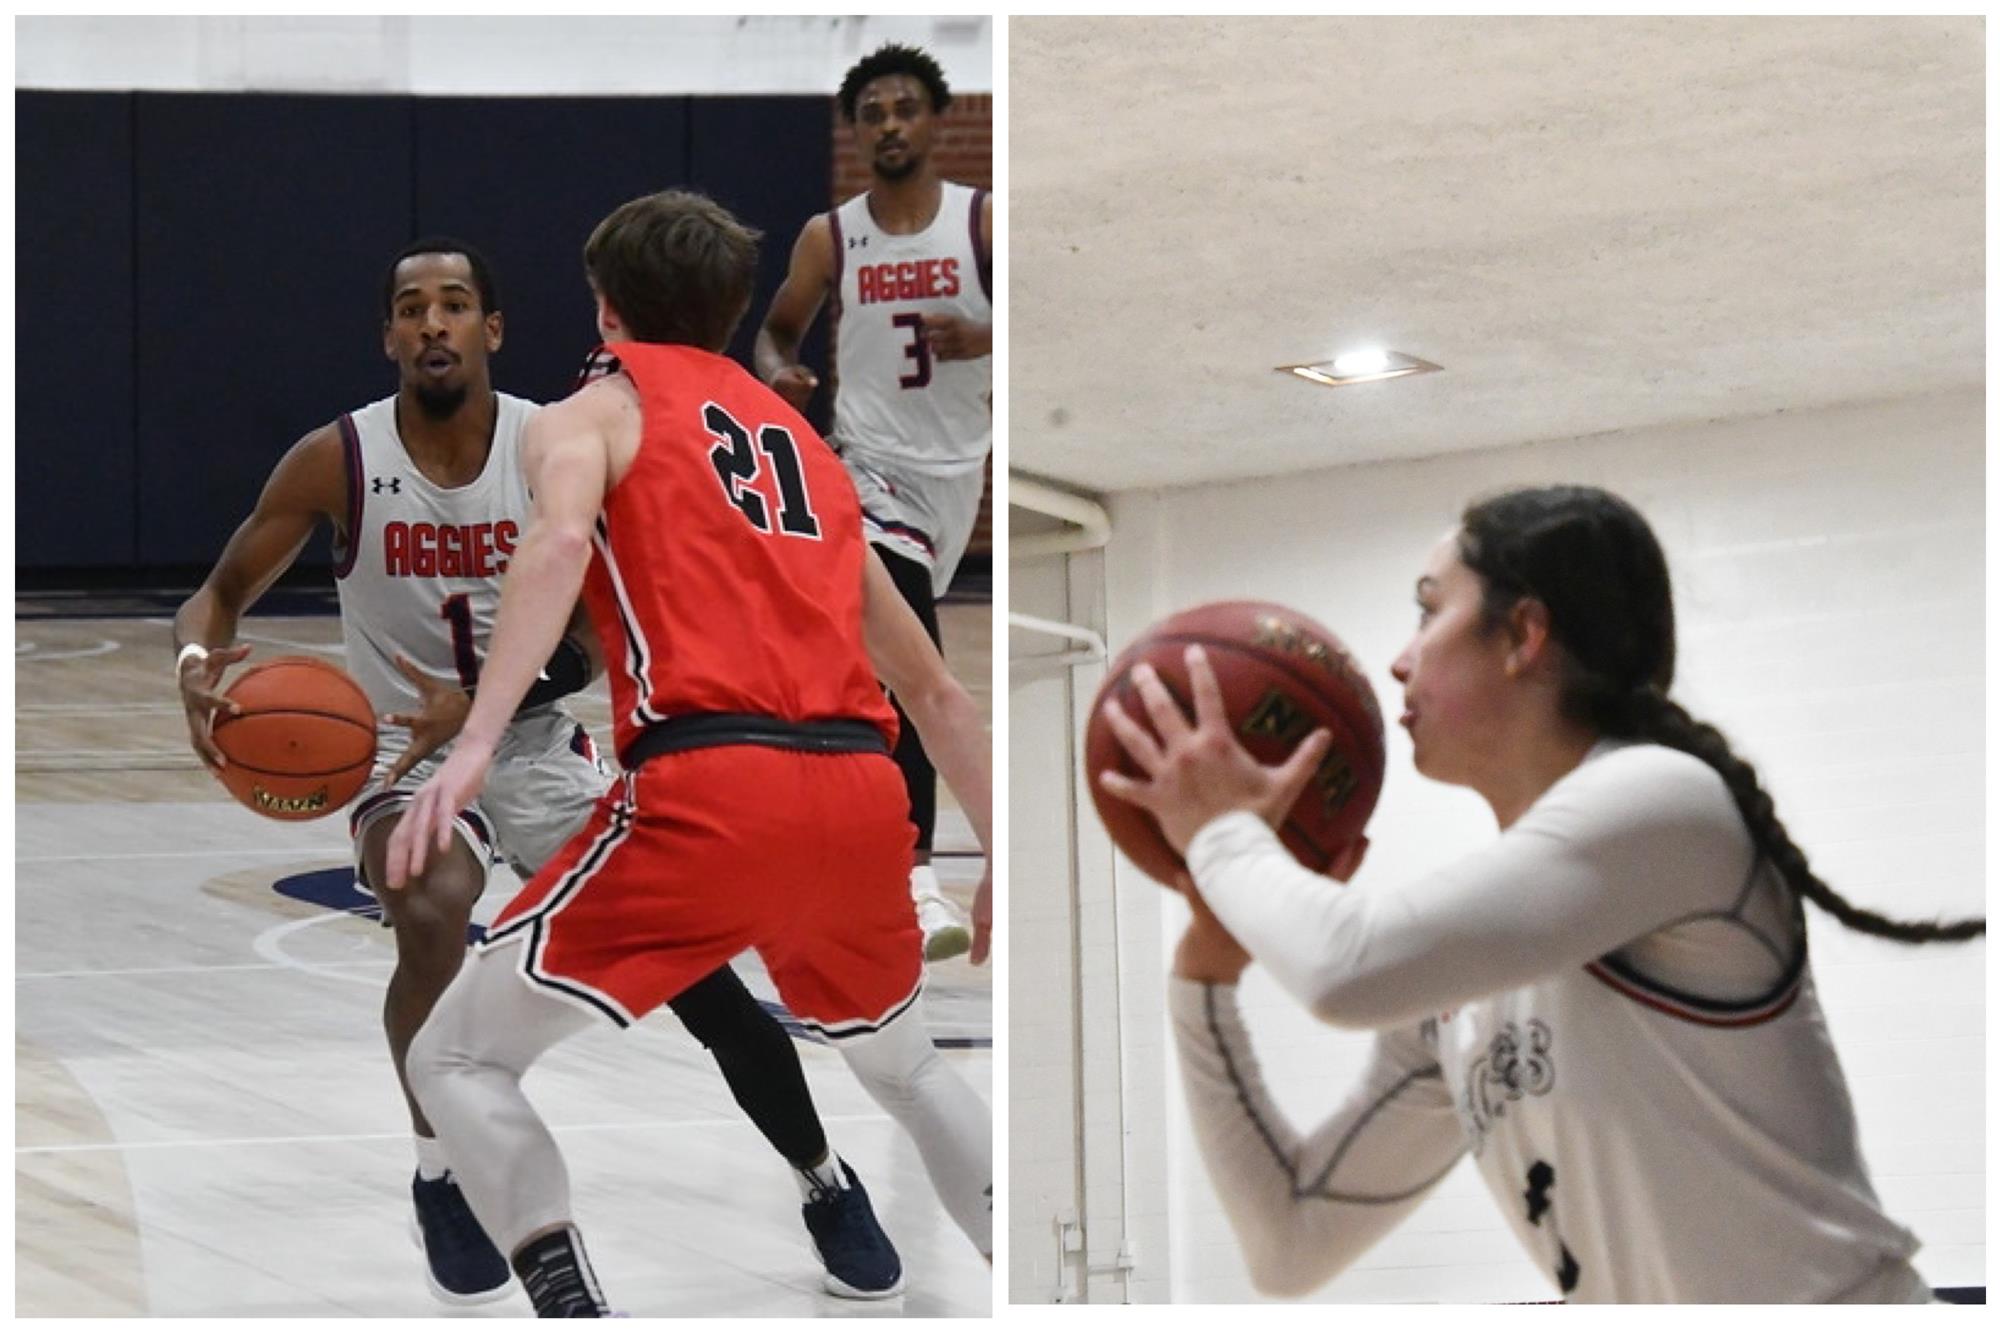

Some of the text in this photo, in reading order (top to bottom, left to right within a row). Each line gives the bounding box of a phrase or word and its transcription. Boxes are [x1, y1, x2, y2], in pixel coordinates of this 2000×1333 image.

[858, 257, 960, 304] AGGIES
[892, 312, 932, 389] 3
[701, 401, 823, 541] 21
[384, 520, 519, 578] AGGIES
[440, 592, 480, 689] 1
